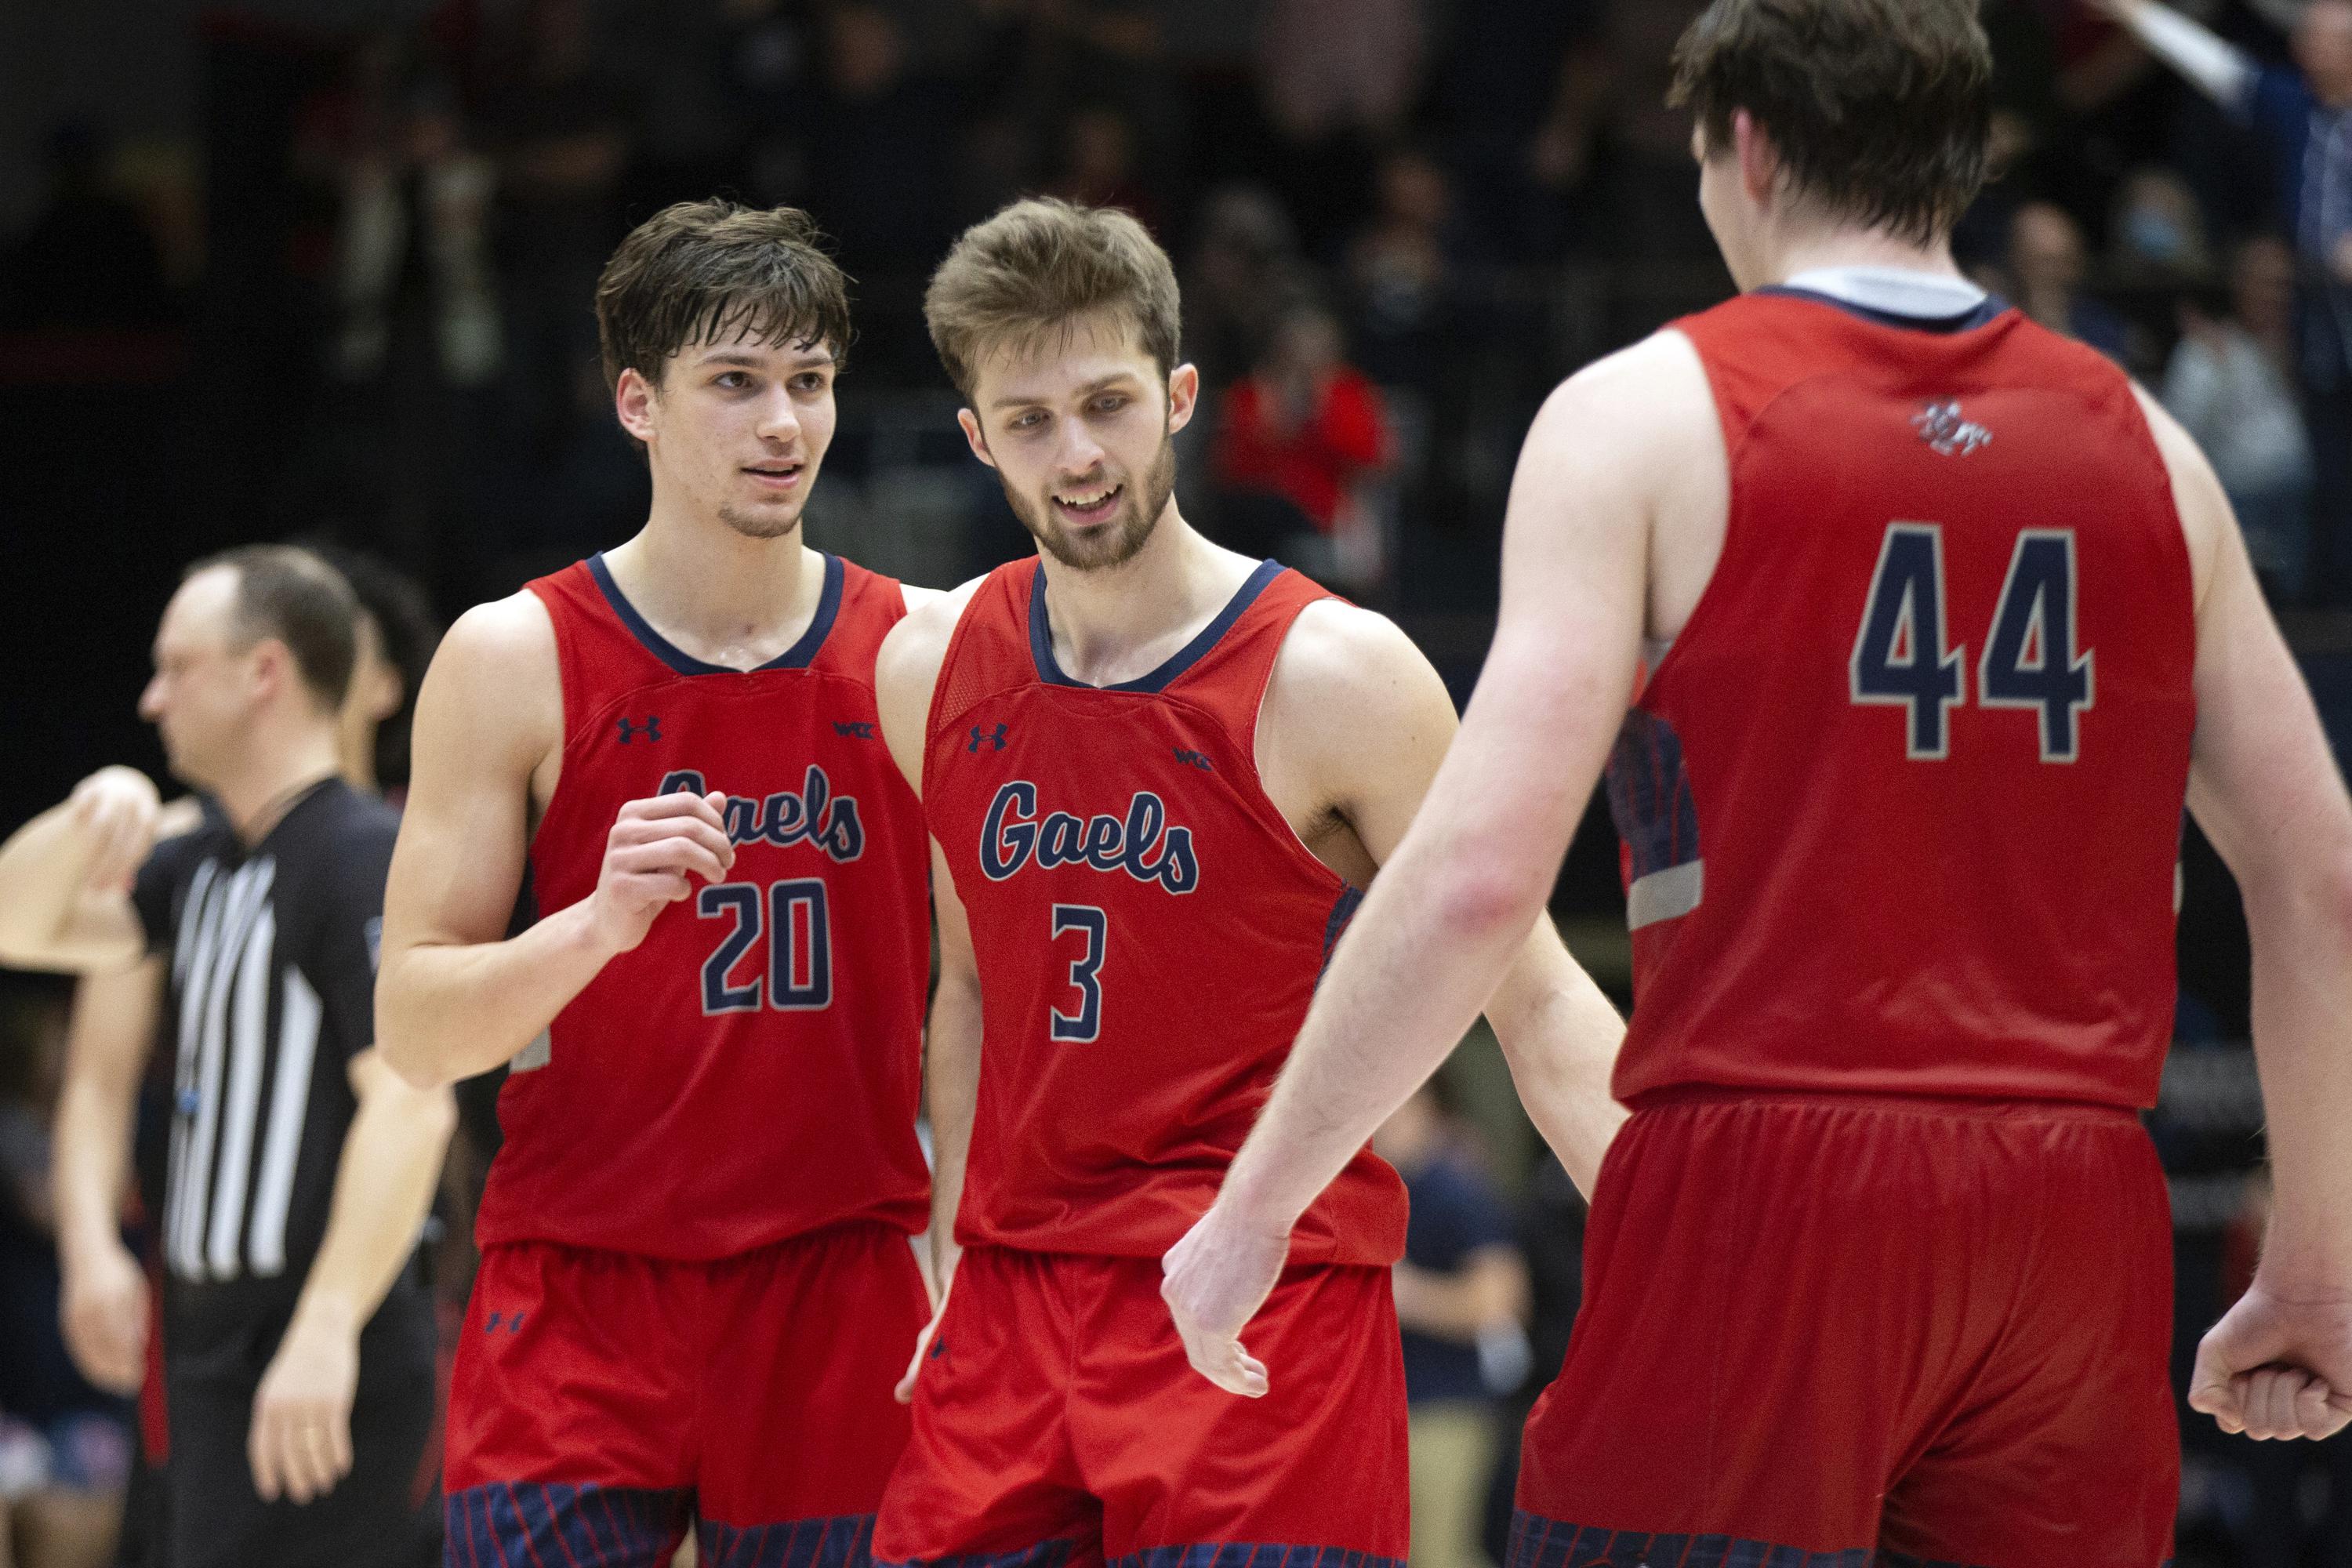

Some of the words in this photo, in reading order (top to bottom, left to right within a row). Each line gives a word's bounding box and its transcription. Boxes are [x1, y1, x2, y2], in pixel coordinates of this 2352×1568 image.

[1849, 521, 2095, 764] 44
[979, 780, 1200, 895] Gaels
[697, 877, 833, 1017] 20
[1051, 903, 1107, 1044] 3
